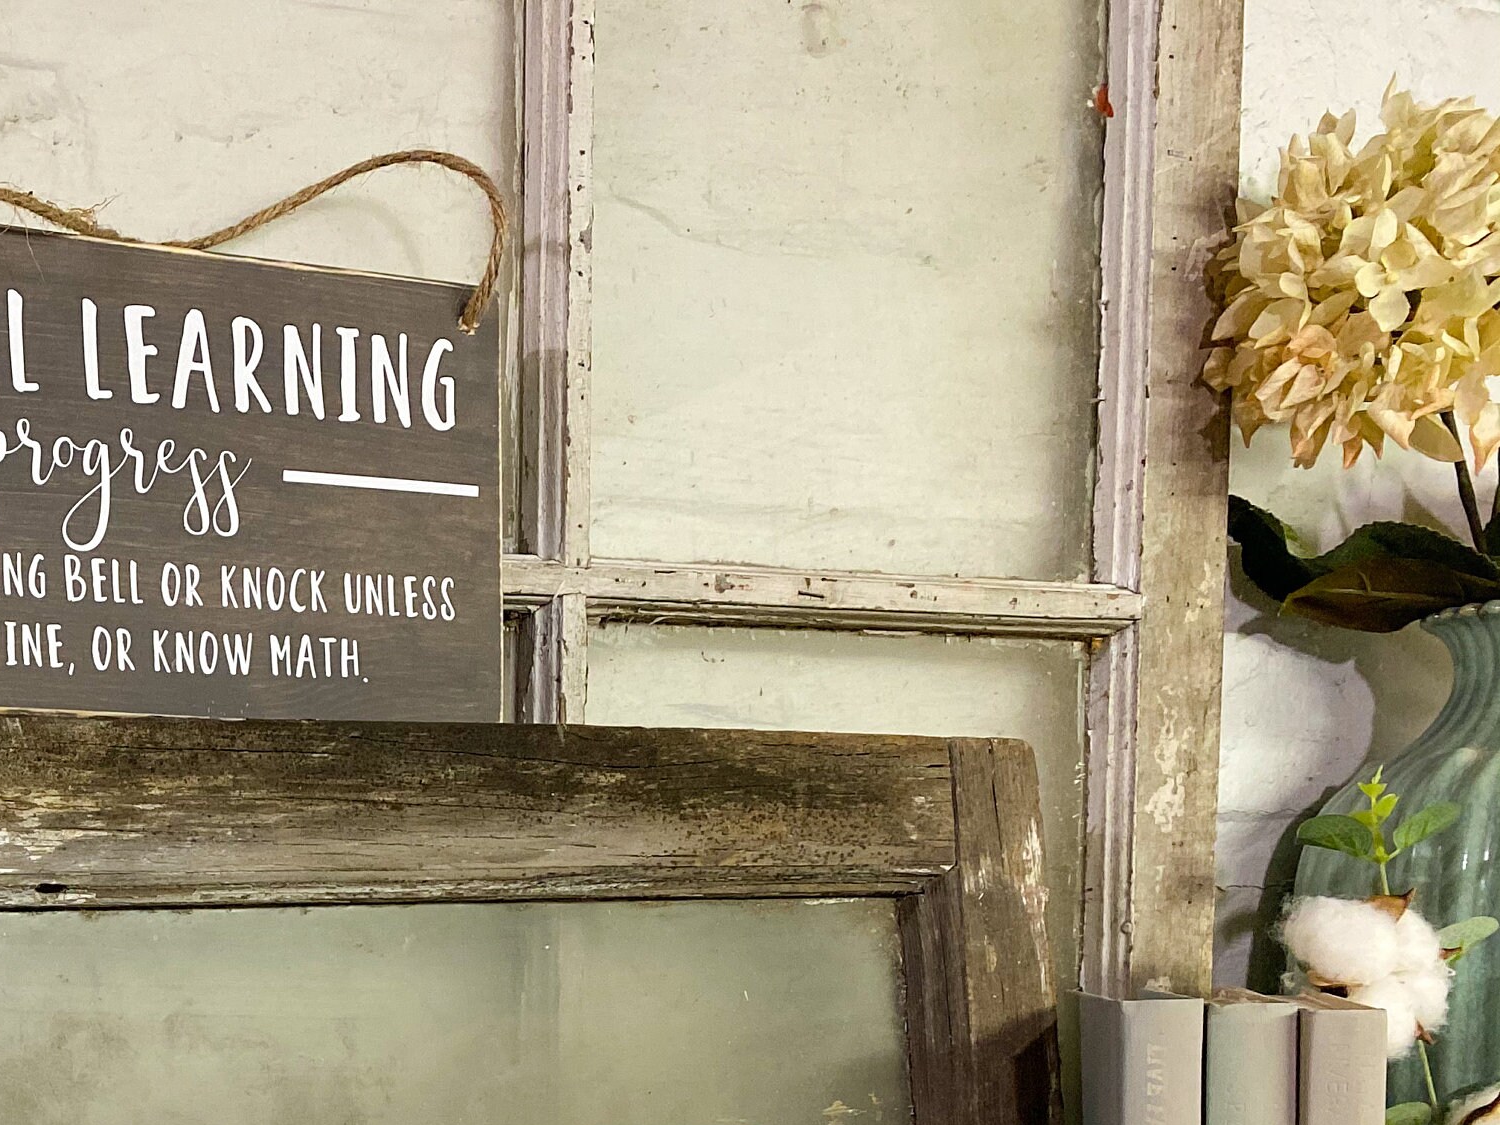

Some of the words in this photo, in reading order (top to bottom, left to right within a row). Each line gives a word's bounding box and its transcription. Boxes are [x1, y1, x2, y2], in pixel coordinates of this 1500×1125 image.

[81, 297, 456, 432] LEARNING
[64, 554, 144, 605] BELL
[161, 561, 204, 608] OR
[221, 565, 328, 614] KNOCK
[343, 572, 456, 622] UNLESS
[91, 625, 136, 673] OR
[153, 629, 253, 677] KNOW
[269, 634, 369, 682] MATH.
